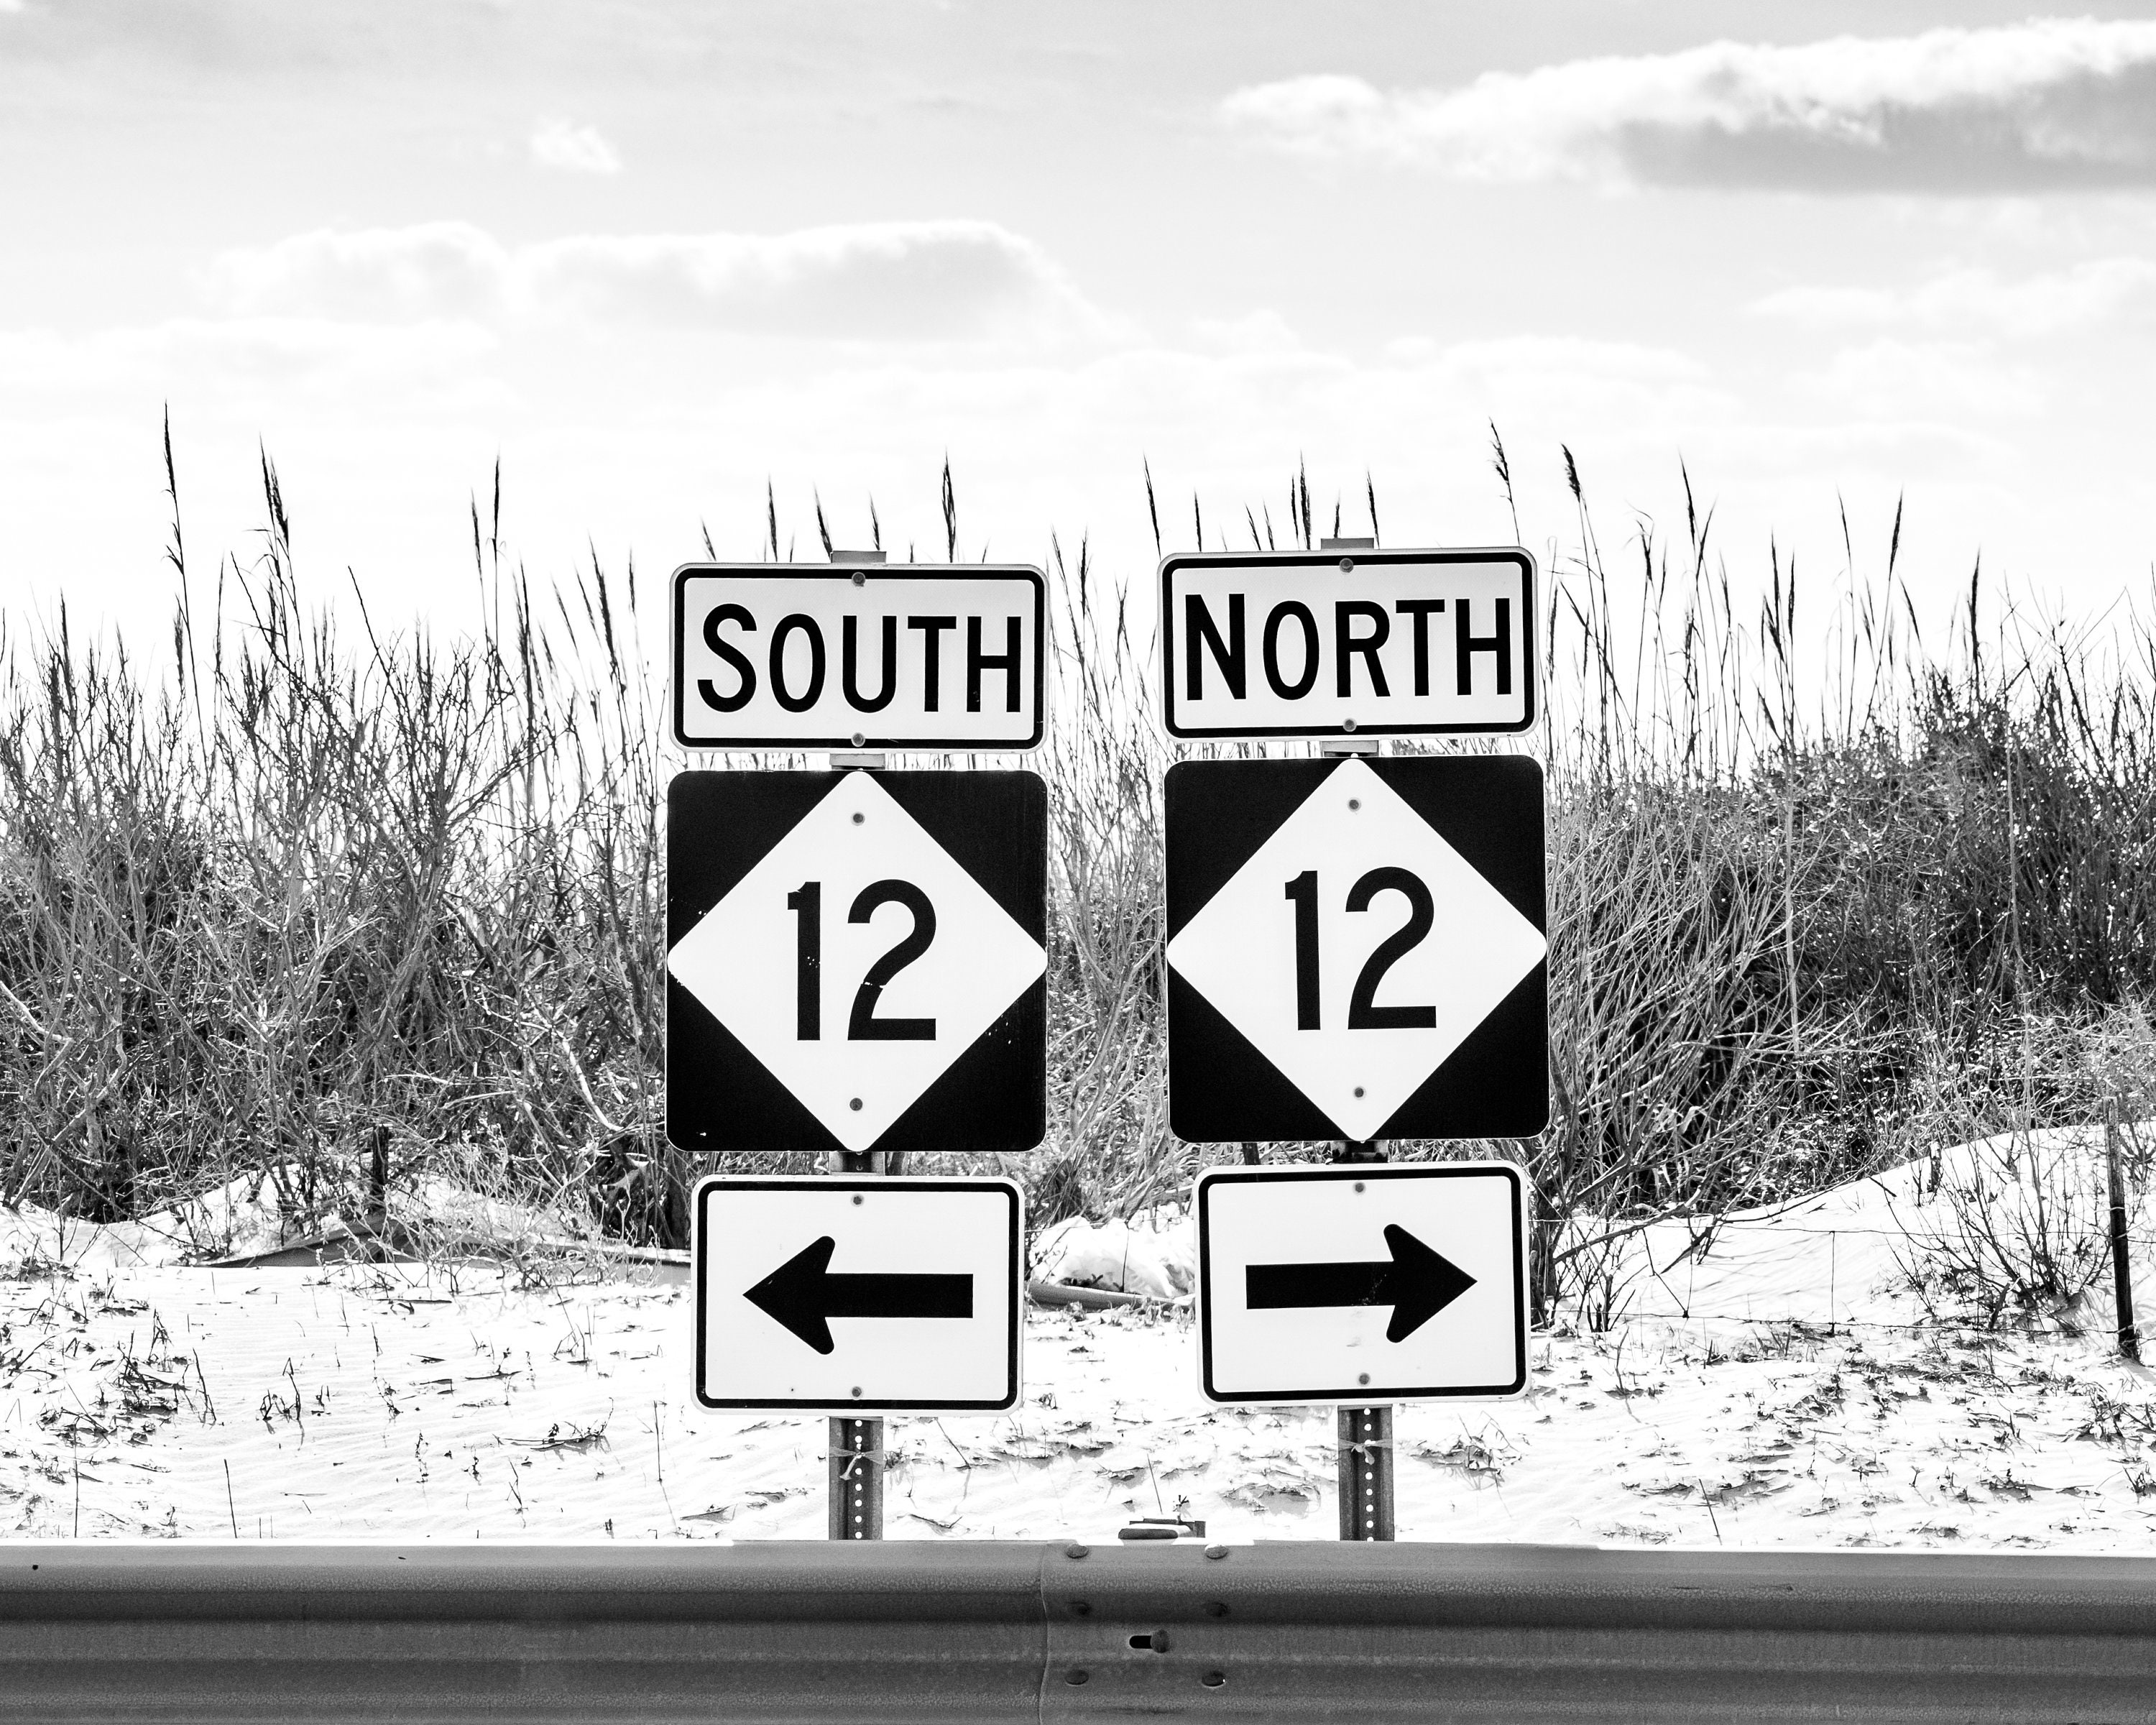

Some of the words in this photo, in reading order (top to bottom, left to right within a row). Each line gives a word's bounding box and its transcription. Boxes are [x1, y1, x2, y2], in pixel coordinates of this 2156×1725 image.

[697, 603, 1022, 713] SOUTH
[1185, 593, 1512, 701] NORTH
[787, 879, 936, 1041] 12
[1284, 866, 1437, 1031] 12
